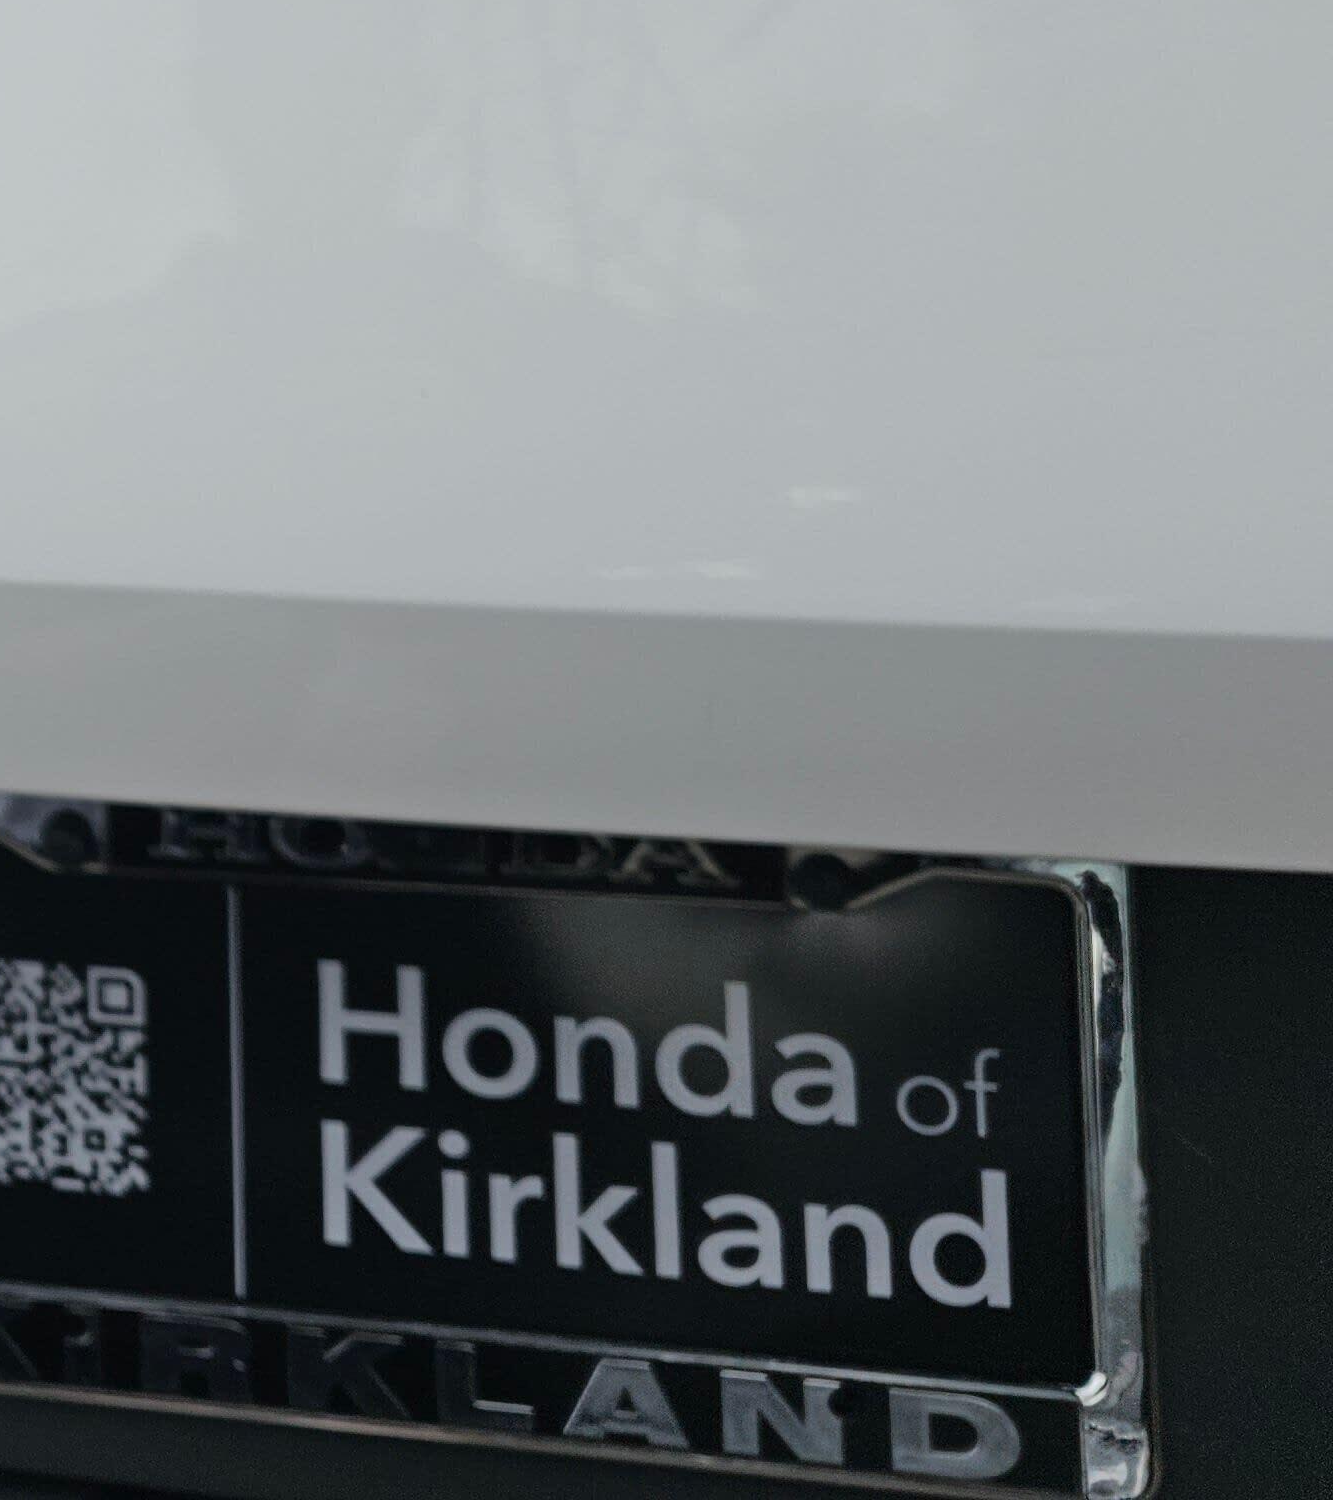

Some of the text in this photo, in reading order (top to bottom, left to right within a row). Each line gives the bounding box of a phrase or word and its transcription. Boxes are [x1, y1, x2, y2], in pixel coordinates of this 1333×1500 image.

[317, 958, 1001, 1138] Honda of
[320, 1118, 1012, 1309] Kirkland
